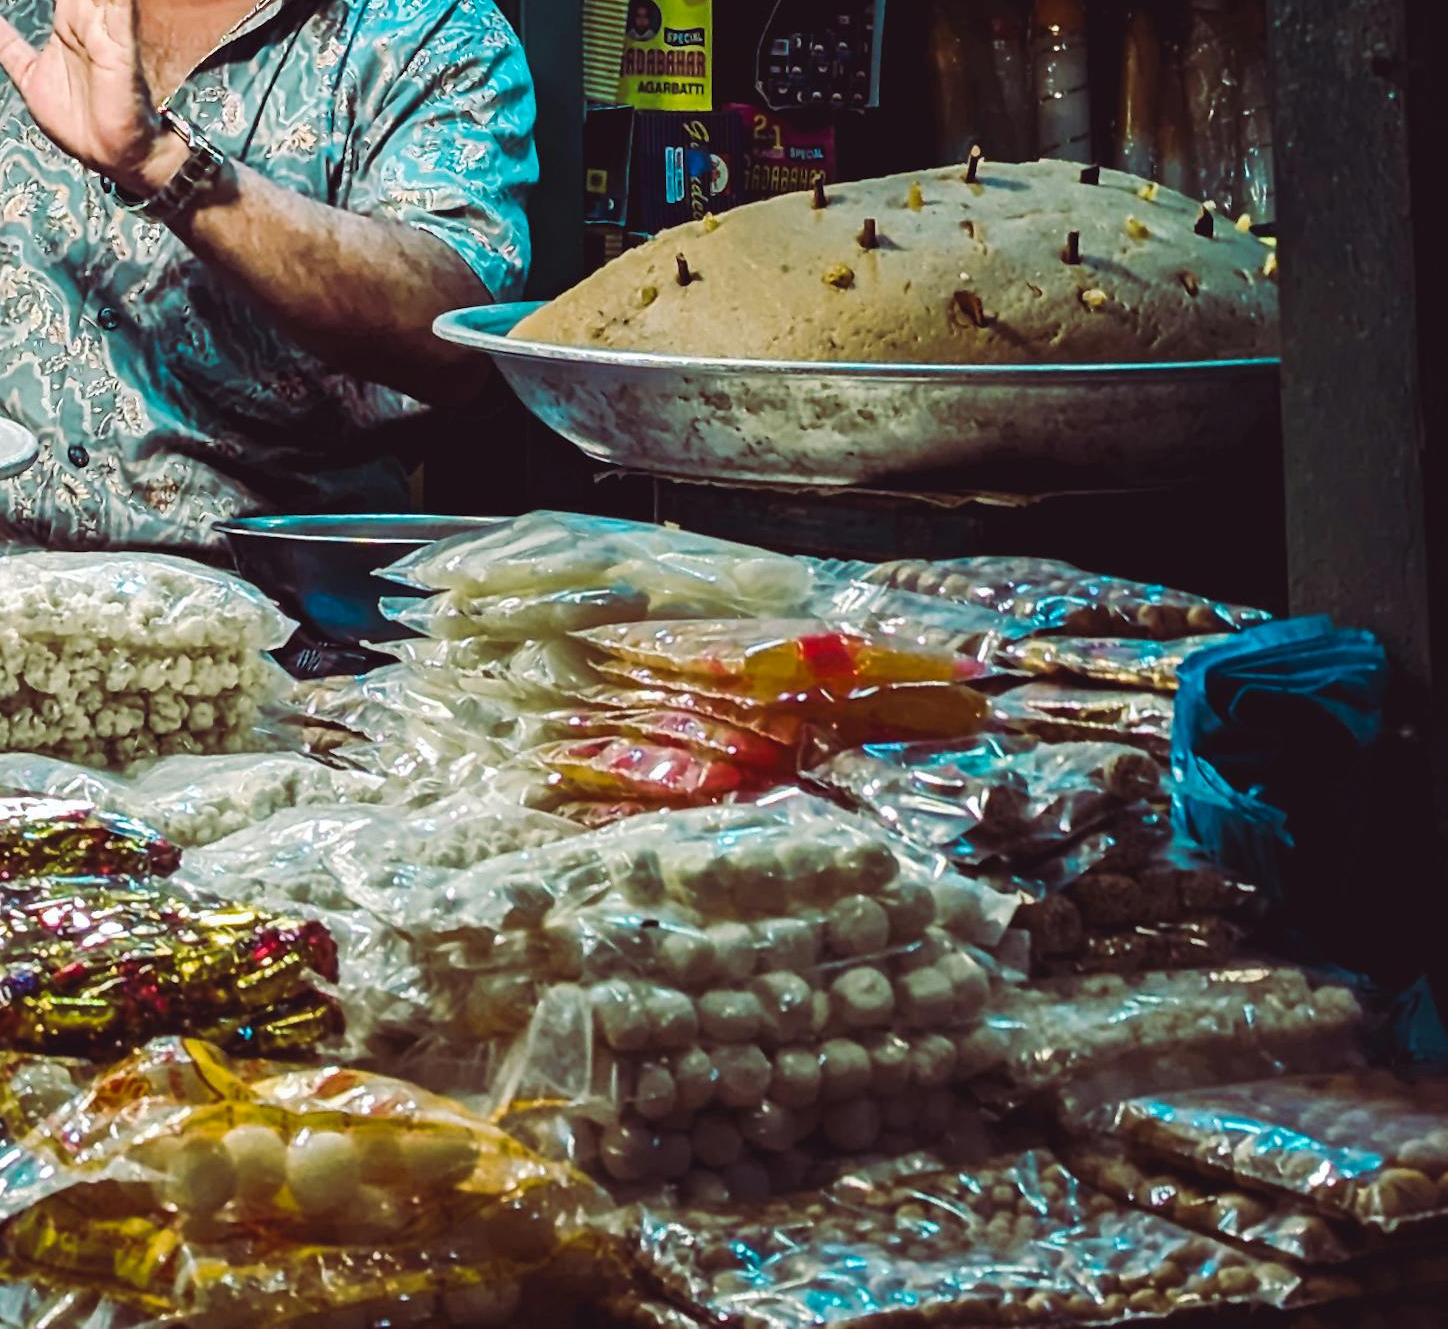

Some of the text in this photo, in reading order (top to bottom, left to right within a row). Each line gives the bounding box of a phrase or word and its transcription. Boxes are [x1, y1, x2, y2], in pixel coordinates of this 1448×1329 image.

[666, 30, 704, 45] SPECIAL
[621, 48, 706, 78] ADABAHAR
[637, 81, 704, 95] AGARBATTI
